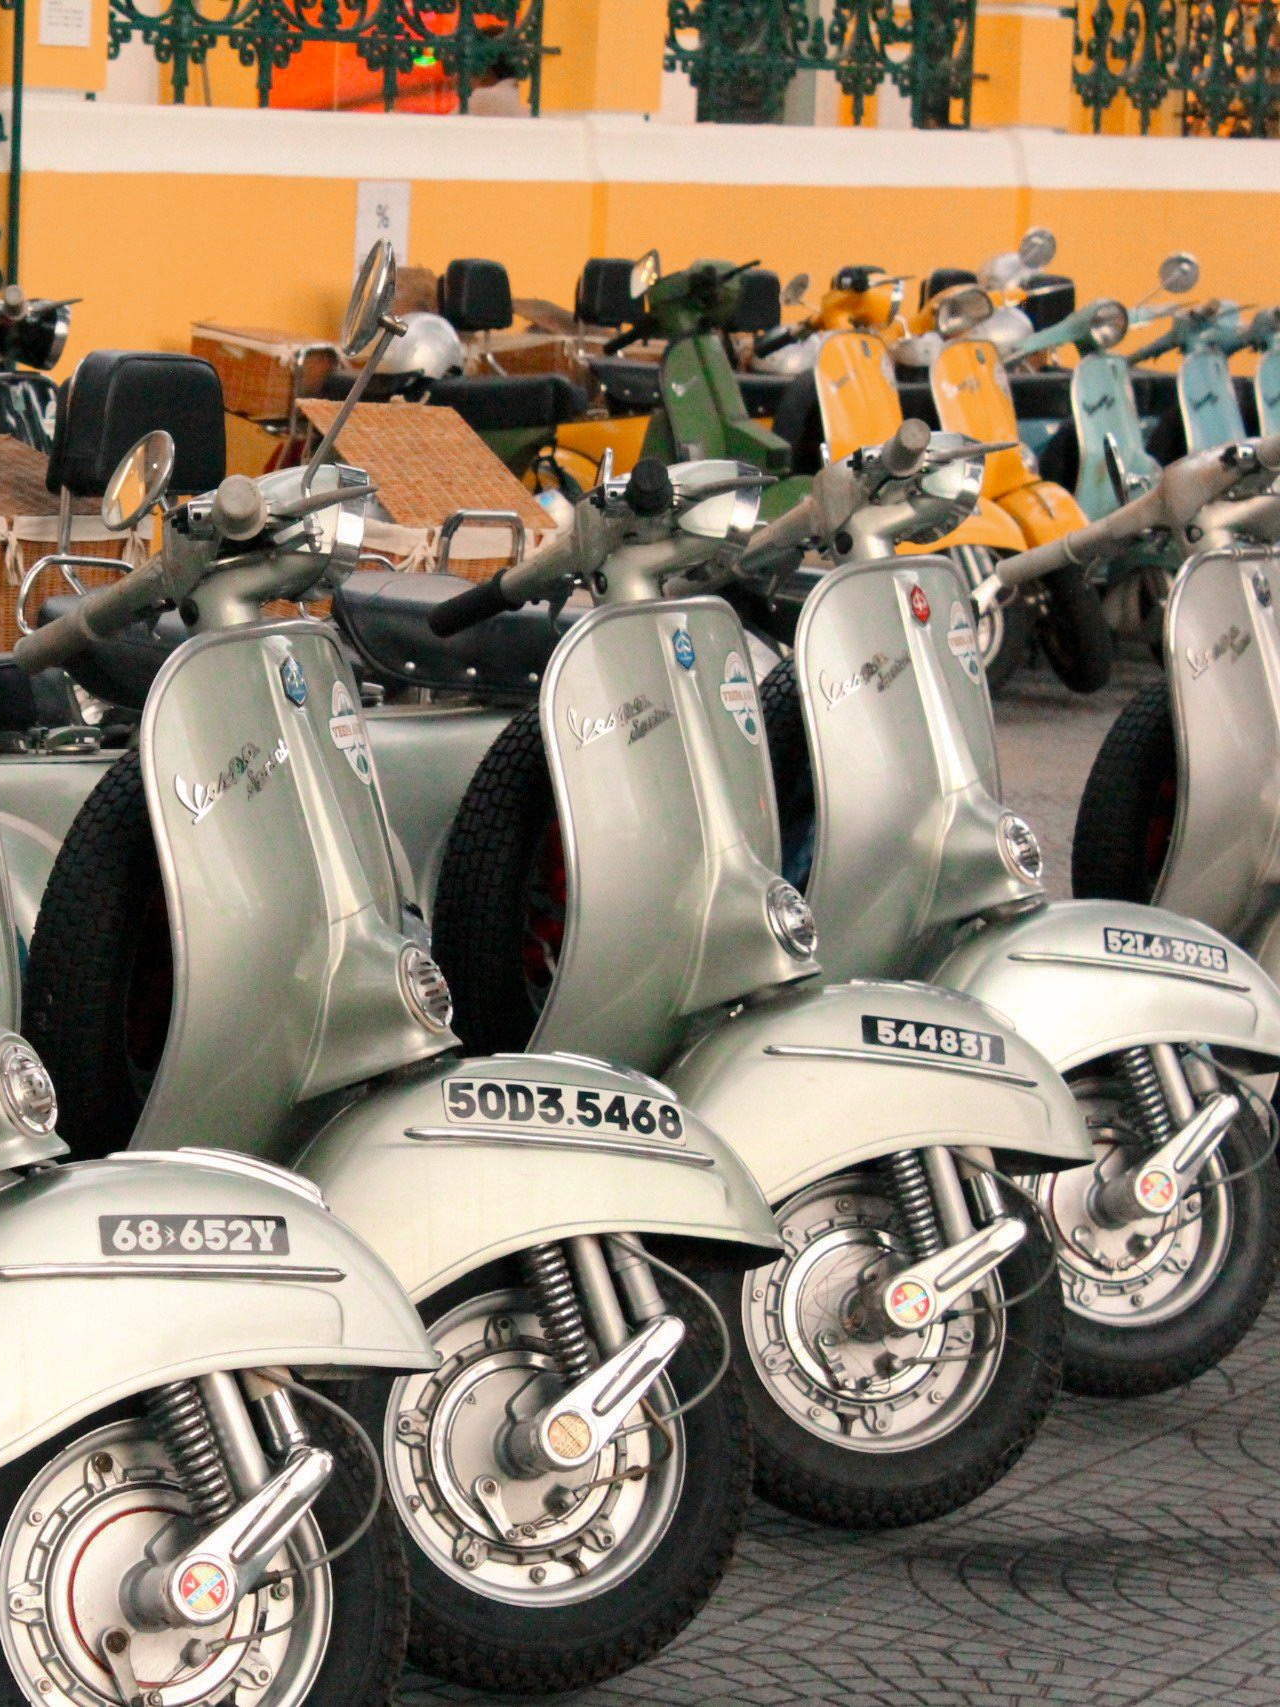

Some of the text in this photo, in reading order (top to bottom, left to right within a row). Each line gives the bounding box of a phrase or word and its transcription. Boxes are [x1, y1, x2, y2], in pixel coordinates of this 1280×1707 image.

[1107, 930, 1226, 970] 52L6 3935
[448, 1082, 683, 1140] 50D3.5468
